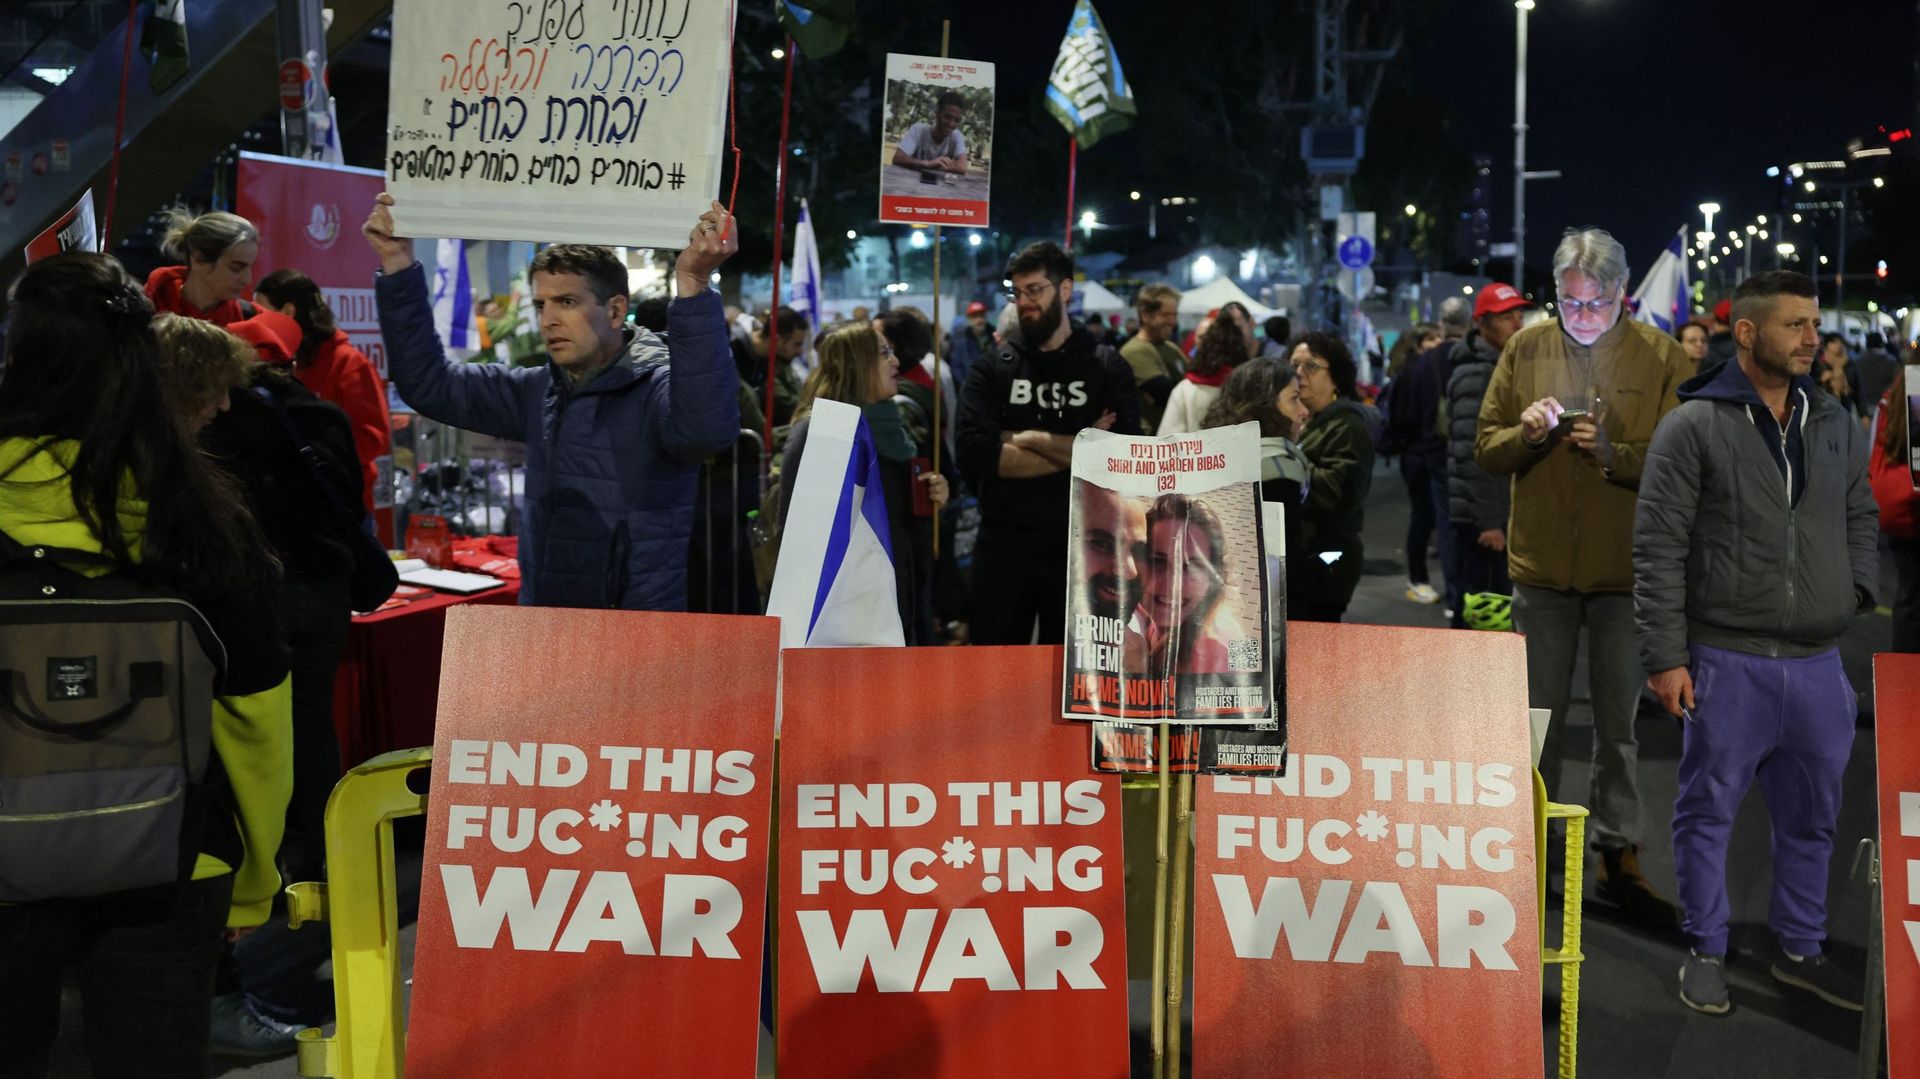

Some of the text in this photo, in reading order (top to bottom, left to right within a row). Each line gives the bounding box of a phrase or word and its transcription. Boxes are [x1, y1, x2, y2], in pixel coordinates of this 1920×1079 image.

[340, 294, 380, 322] ונות
[1130, 443, 1153, 459] ביבס
[1180, 439, 1203, 456] שירי
[1107, 453, 1226, 475] SHIRI AND YARDEN BIBAS
[1157, 473, 1176, 493] (32)
[1075, 613, 1124, 645] BRING
[1074, 641, 1119, 673] THEM
[1073, 673, 1176, 706] HOME NOW!
[1195, 686, 1225, 696] HOSTAGES
[1195, 695, 1263, 709] FAMILIES FORUM
[1217, 743, 1282, 754] HOSTAGES AND MISSING
[1217, 753, 1281, 767] FAMILIES FORUM
[448, 739, 756, 796] END THIS
[1361, 757, 1516, 808] THIS
[797, 780, 1105, 828] END THIS
[439, 864, 744, 960] WAR
[1211, 874, 1520, 971] WAR
[795, 906, 1107, 994] WAR
